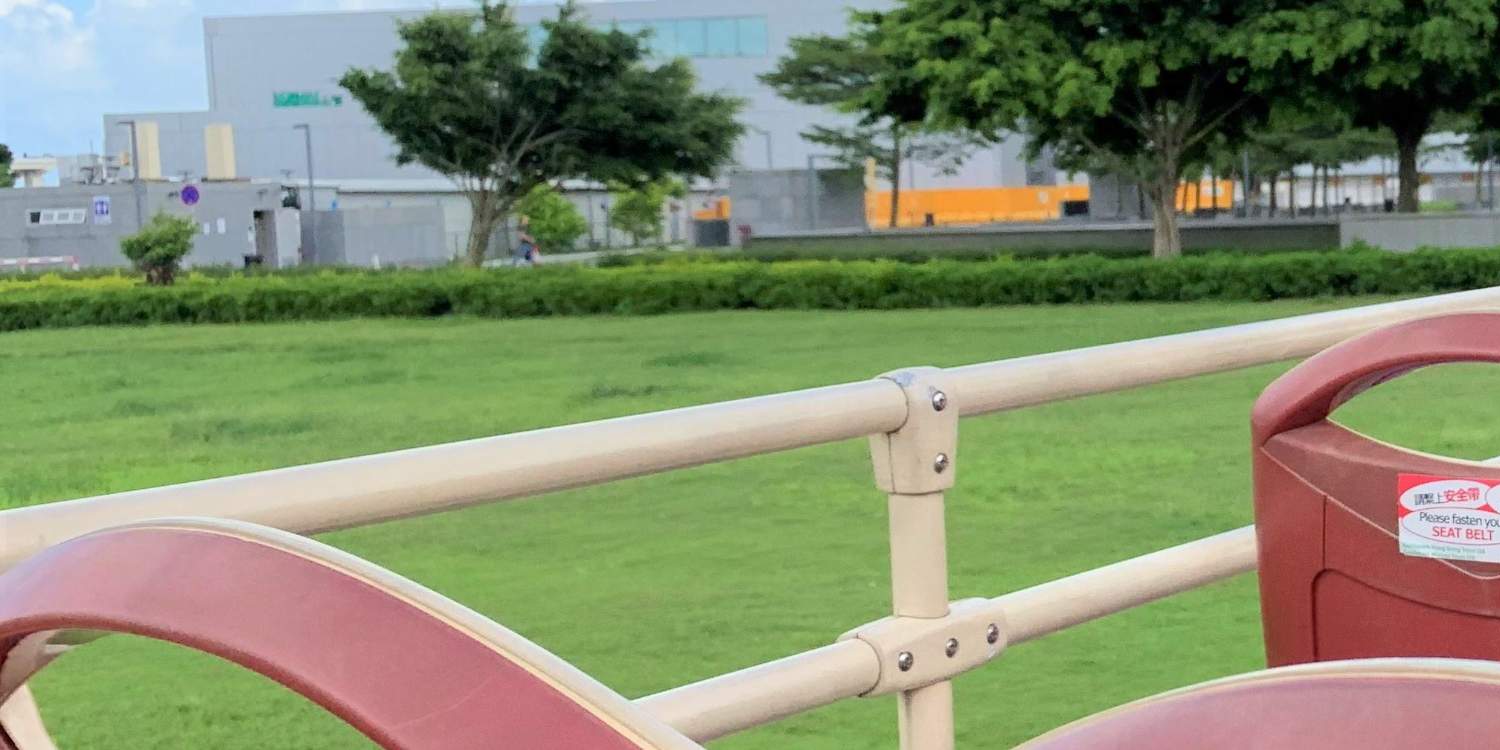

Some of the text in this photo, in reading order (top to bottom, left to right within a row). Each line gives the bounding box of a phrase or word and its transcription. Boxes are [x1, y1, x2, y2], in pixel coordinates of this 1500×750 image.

[1419, 512, 1450, 525] Please
[1432, 526, 1494, 541] SEAT BELT
